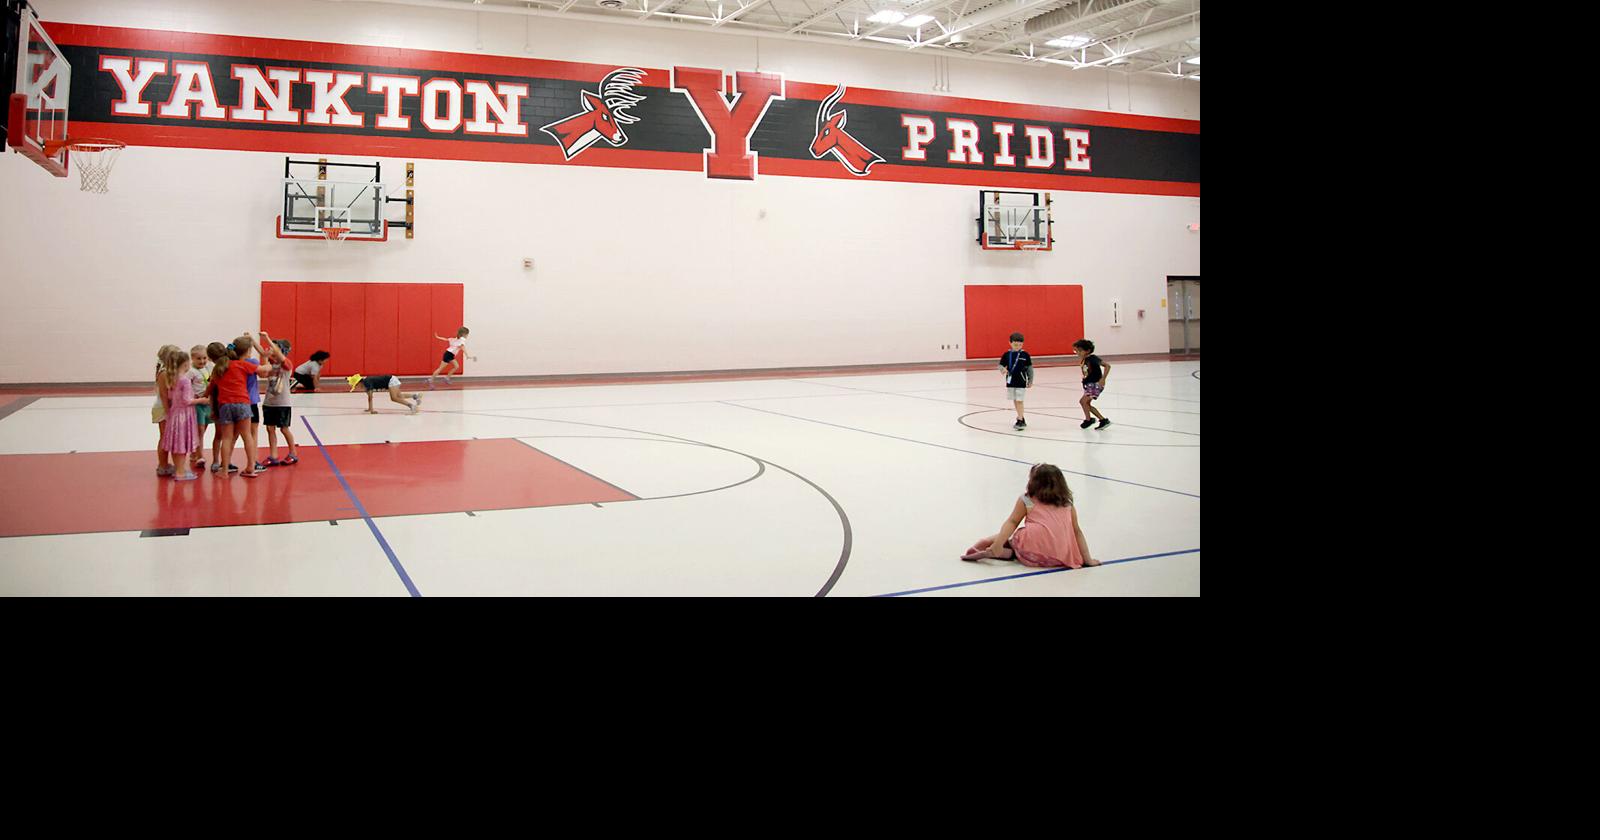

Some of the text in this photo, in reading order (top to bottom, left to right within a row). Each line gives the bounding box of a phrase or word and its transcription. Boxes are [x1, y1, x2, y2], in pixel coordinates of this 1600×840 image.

[98, 54, 530, 137] YANKTON
[669, 65, 786, 181] Y
[901, 114, 1092, 172] PRIDE
